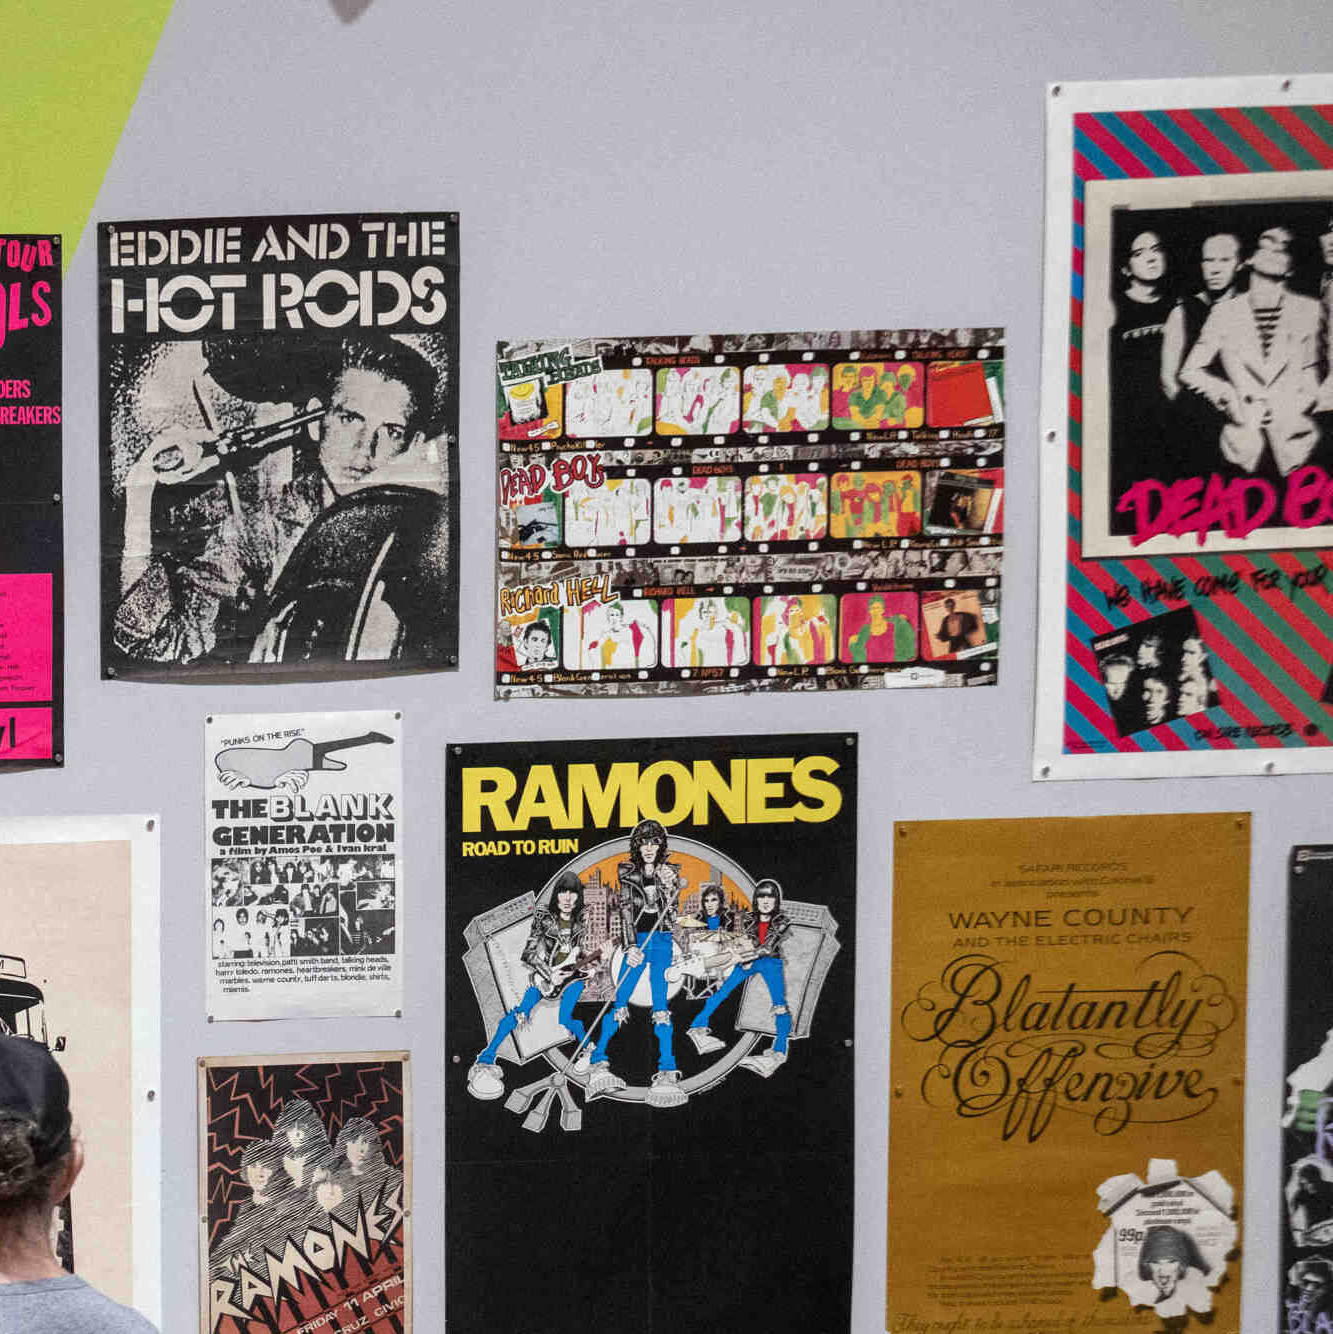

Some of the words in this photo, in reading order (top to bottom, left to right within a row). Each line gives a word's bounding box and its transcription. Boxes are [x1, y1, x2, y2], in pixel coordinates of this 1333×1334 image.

[110, 227, 242, 266] EDDIE
[252, 223, 350, 263] AND
[361, 221, 446, 258] THE
[111, 274, 247, 333] HOT
[262, 266, 447, 330] RODS
[1115, 473, 1278, 548] DEAD
[212, 799, 268, 820] THE
[270, 793, 395, 822] BLANK
[462, 755, 843, 833] RAMONES
[212, 823, 395, 847] GENERATION
[462, 841, 510, 857] ROAD
[512, 839, 537, 855] TO
[537, 838, 579, 855] RUIN
[948, 909, 1053, 930] WAYNE
[1062, 906, 1196, 927] COUNTY
[902, 951, 1238, 1060] Blatantly
[921, 1040, 1219, 1144] Offensive
[1118, 1227, 1144, 1246] 99p
[362, 1277, 405, 1302] APRIL
